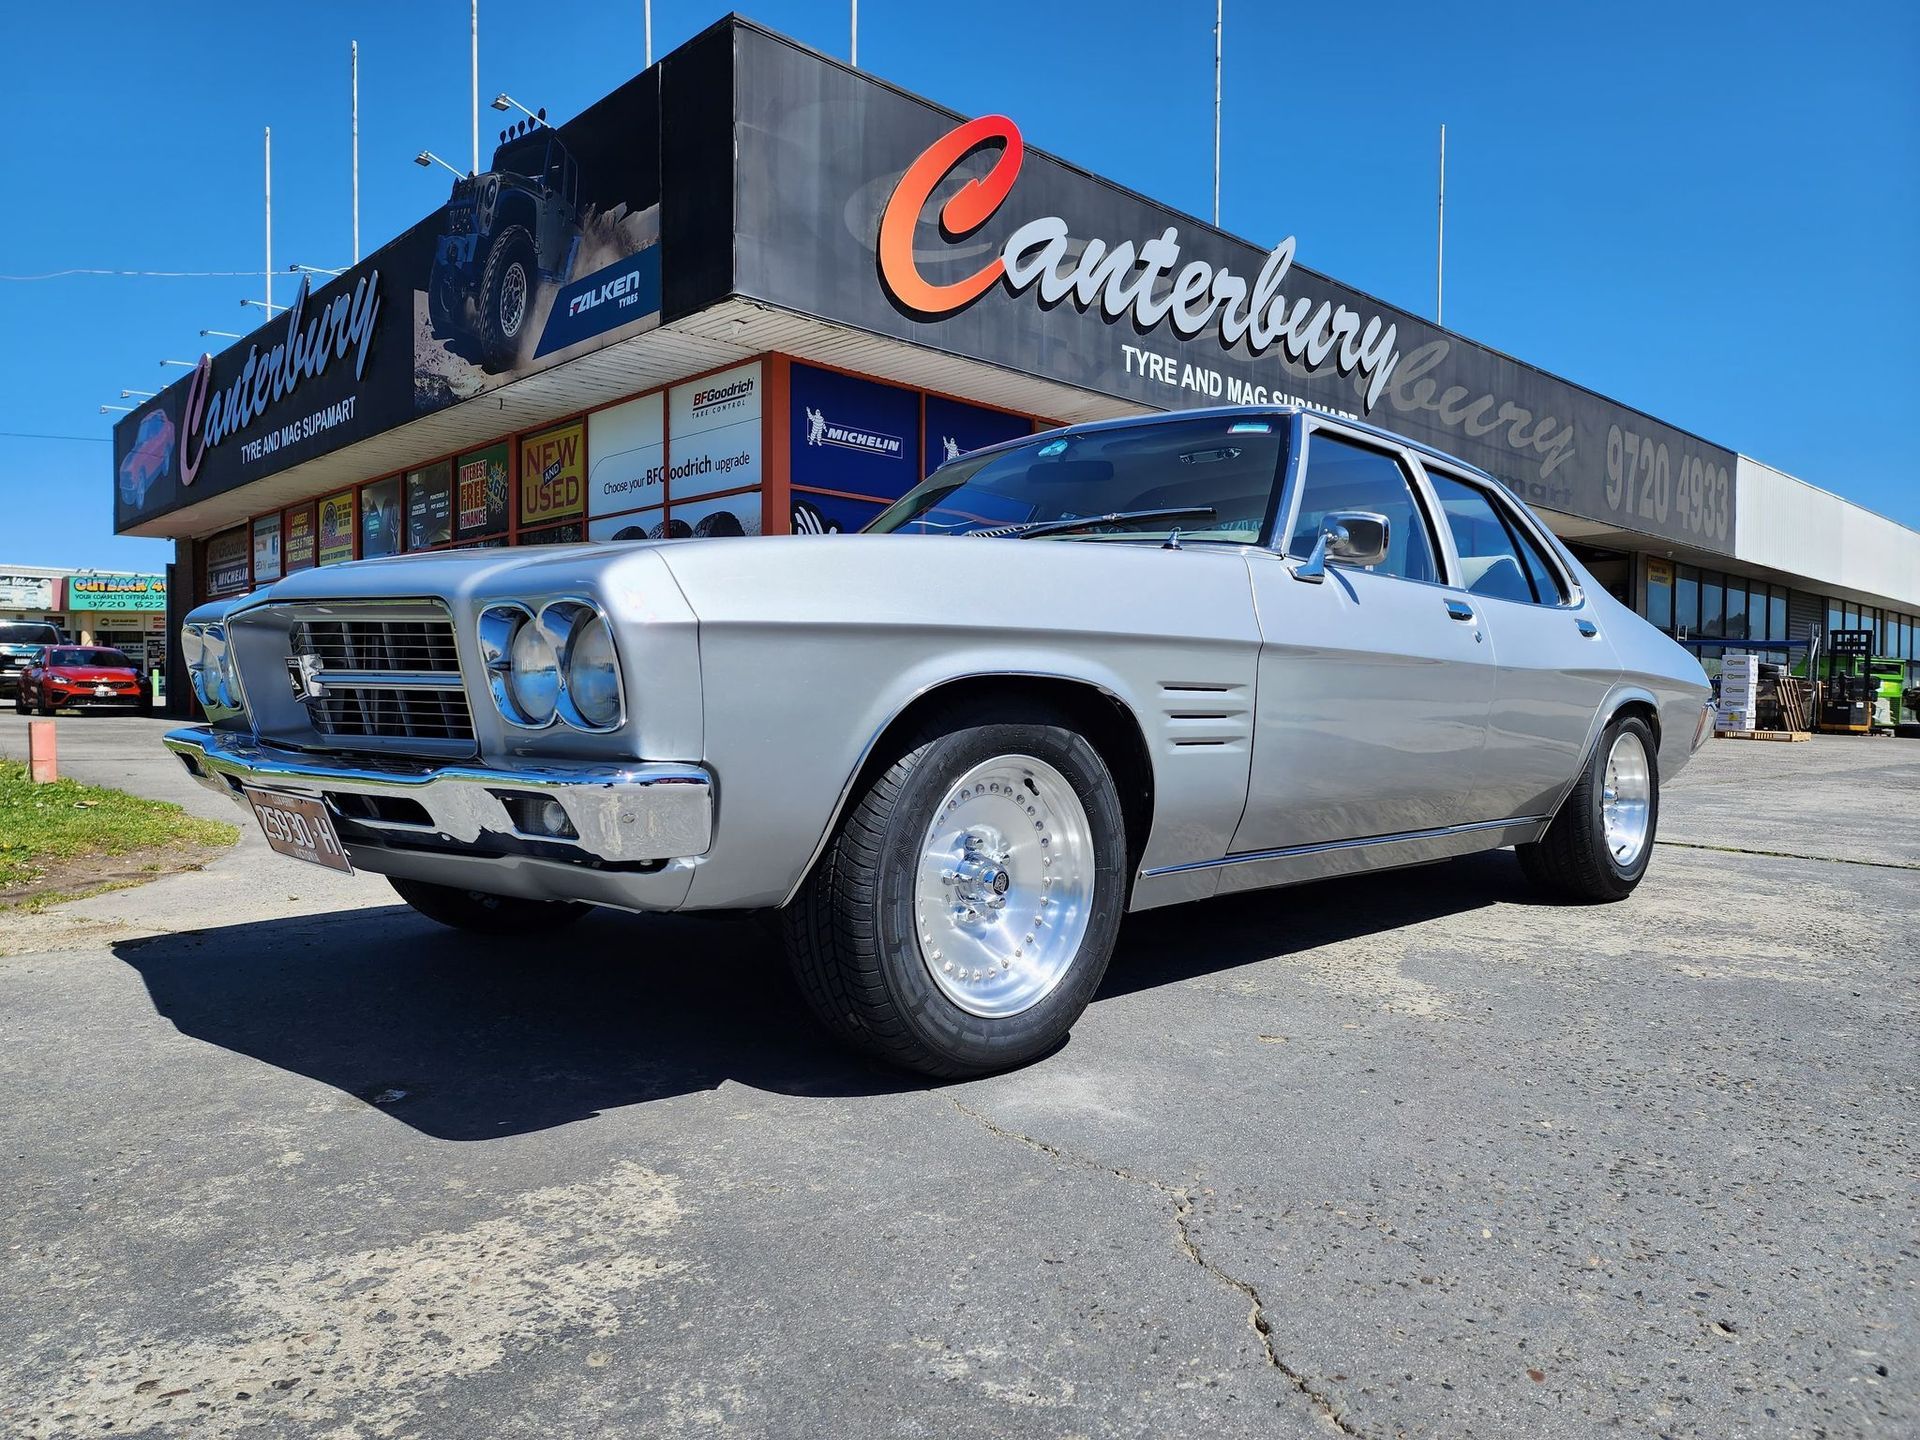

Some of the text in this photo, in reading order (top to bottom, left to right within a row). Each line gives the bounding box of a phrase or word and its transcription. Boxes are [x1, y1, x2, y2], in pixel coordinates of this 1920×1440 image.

[880, 113, 1400, 410] Canterbury
[569, 270, 640, 317] FALKEN
[619, 293, 638, 309] TYRES
[181, 270, 380, 487] Canterbury
[1121, 344, 1268, 405] TYRE AND MAG
[693, 377, 754, 407] BFGoodrich
[692, 400, 746, 419] TAKE CONTROL
[241, 396, 356, 465] TYRE AND MAG SUPAMART
[827, 428, 900, 452] MICHELIN
[461, 460, 487, 482] INTEREST
[526, 434, 580, 478] NEW
[544, 463, 560, 482] AND
[604, 482, 628, 495] Choose
[629, 477, 645, 494] your
[715, 450, 750, 475] upgrade
[461, 479, 487, 513] FREE
[526, 476, 580, 514] USED
[1606, 424, 1729, 542] 9720 4933
[461, 508, 487, 530] FINANCE
[74, 577, 148, 593] OUTBACK
[88, 601, 126, 609] 9720
